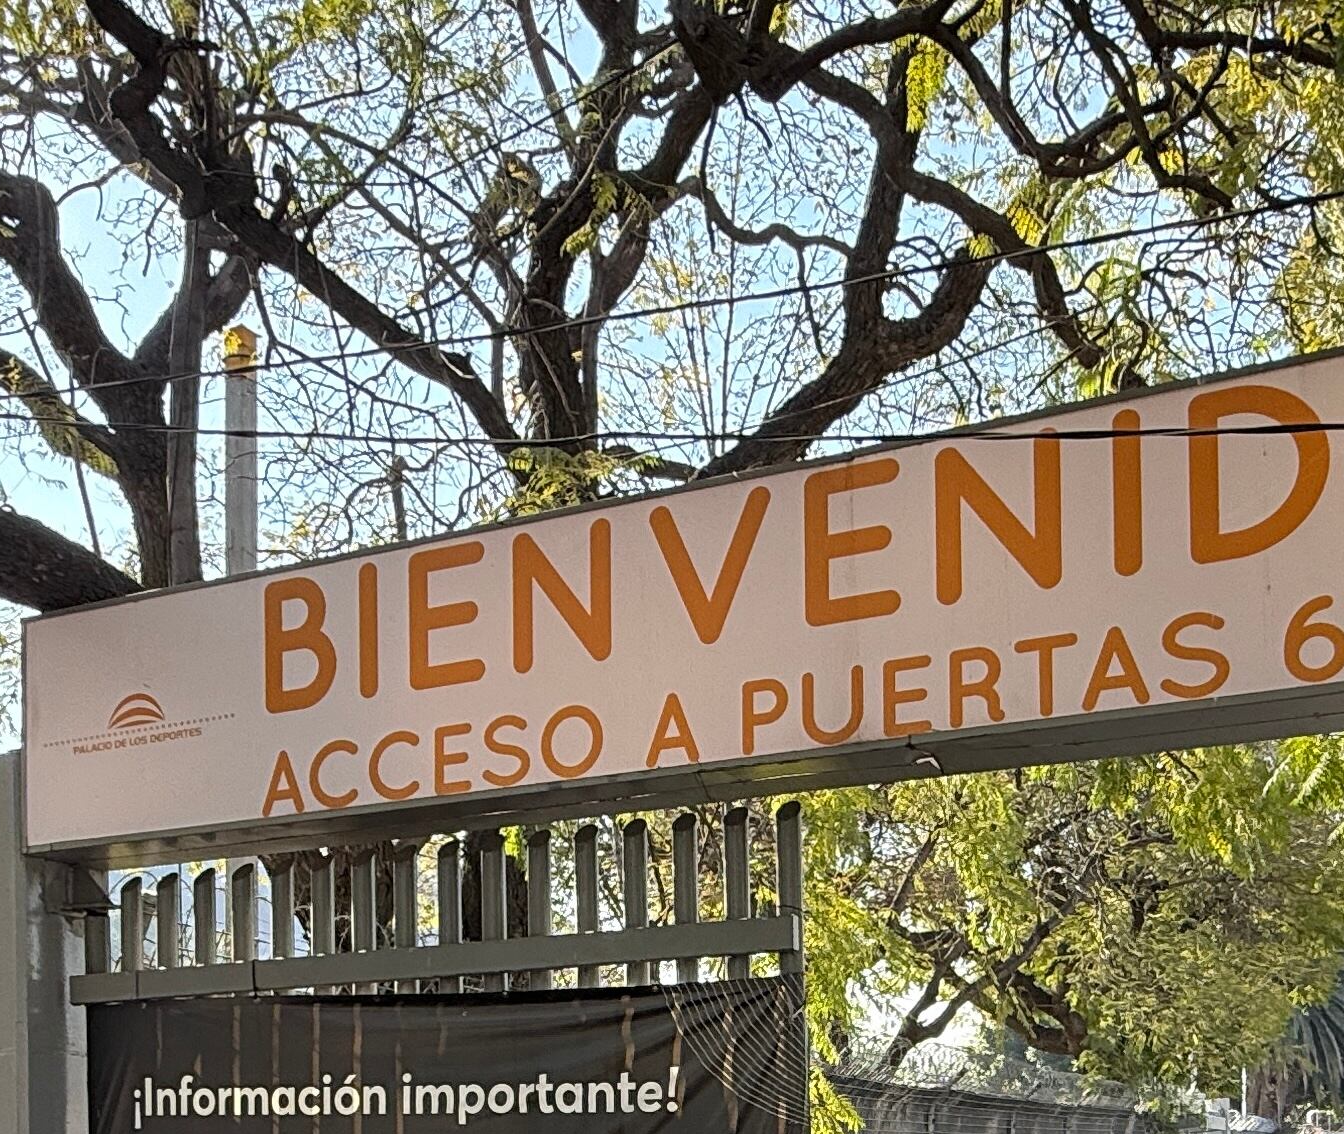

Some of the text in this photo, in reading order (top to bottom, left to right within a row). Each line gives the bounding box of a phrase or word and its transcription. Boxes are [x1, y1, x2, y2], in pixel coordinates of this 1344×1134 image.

[72, 727, 203, 755] PALACIO DE LOS DEPORTES
[262, 705, 604, 817] ACCESO
[646, 692, 700, 768] A
[741, 611, 1231, 756] PUERTAS
[133, 1066, 680, 1129] ¡Información importante!
